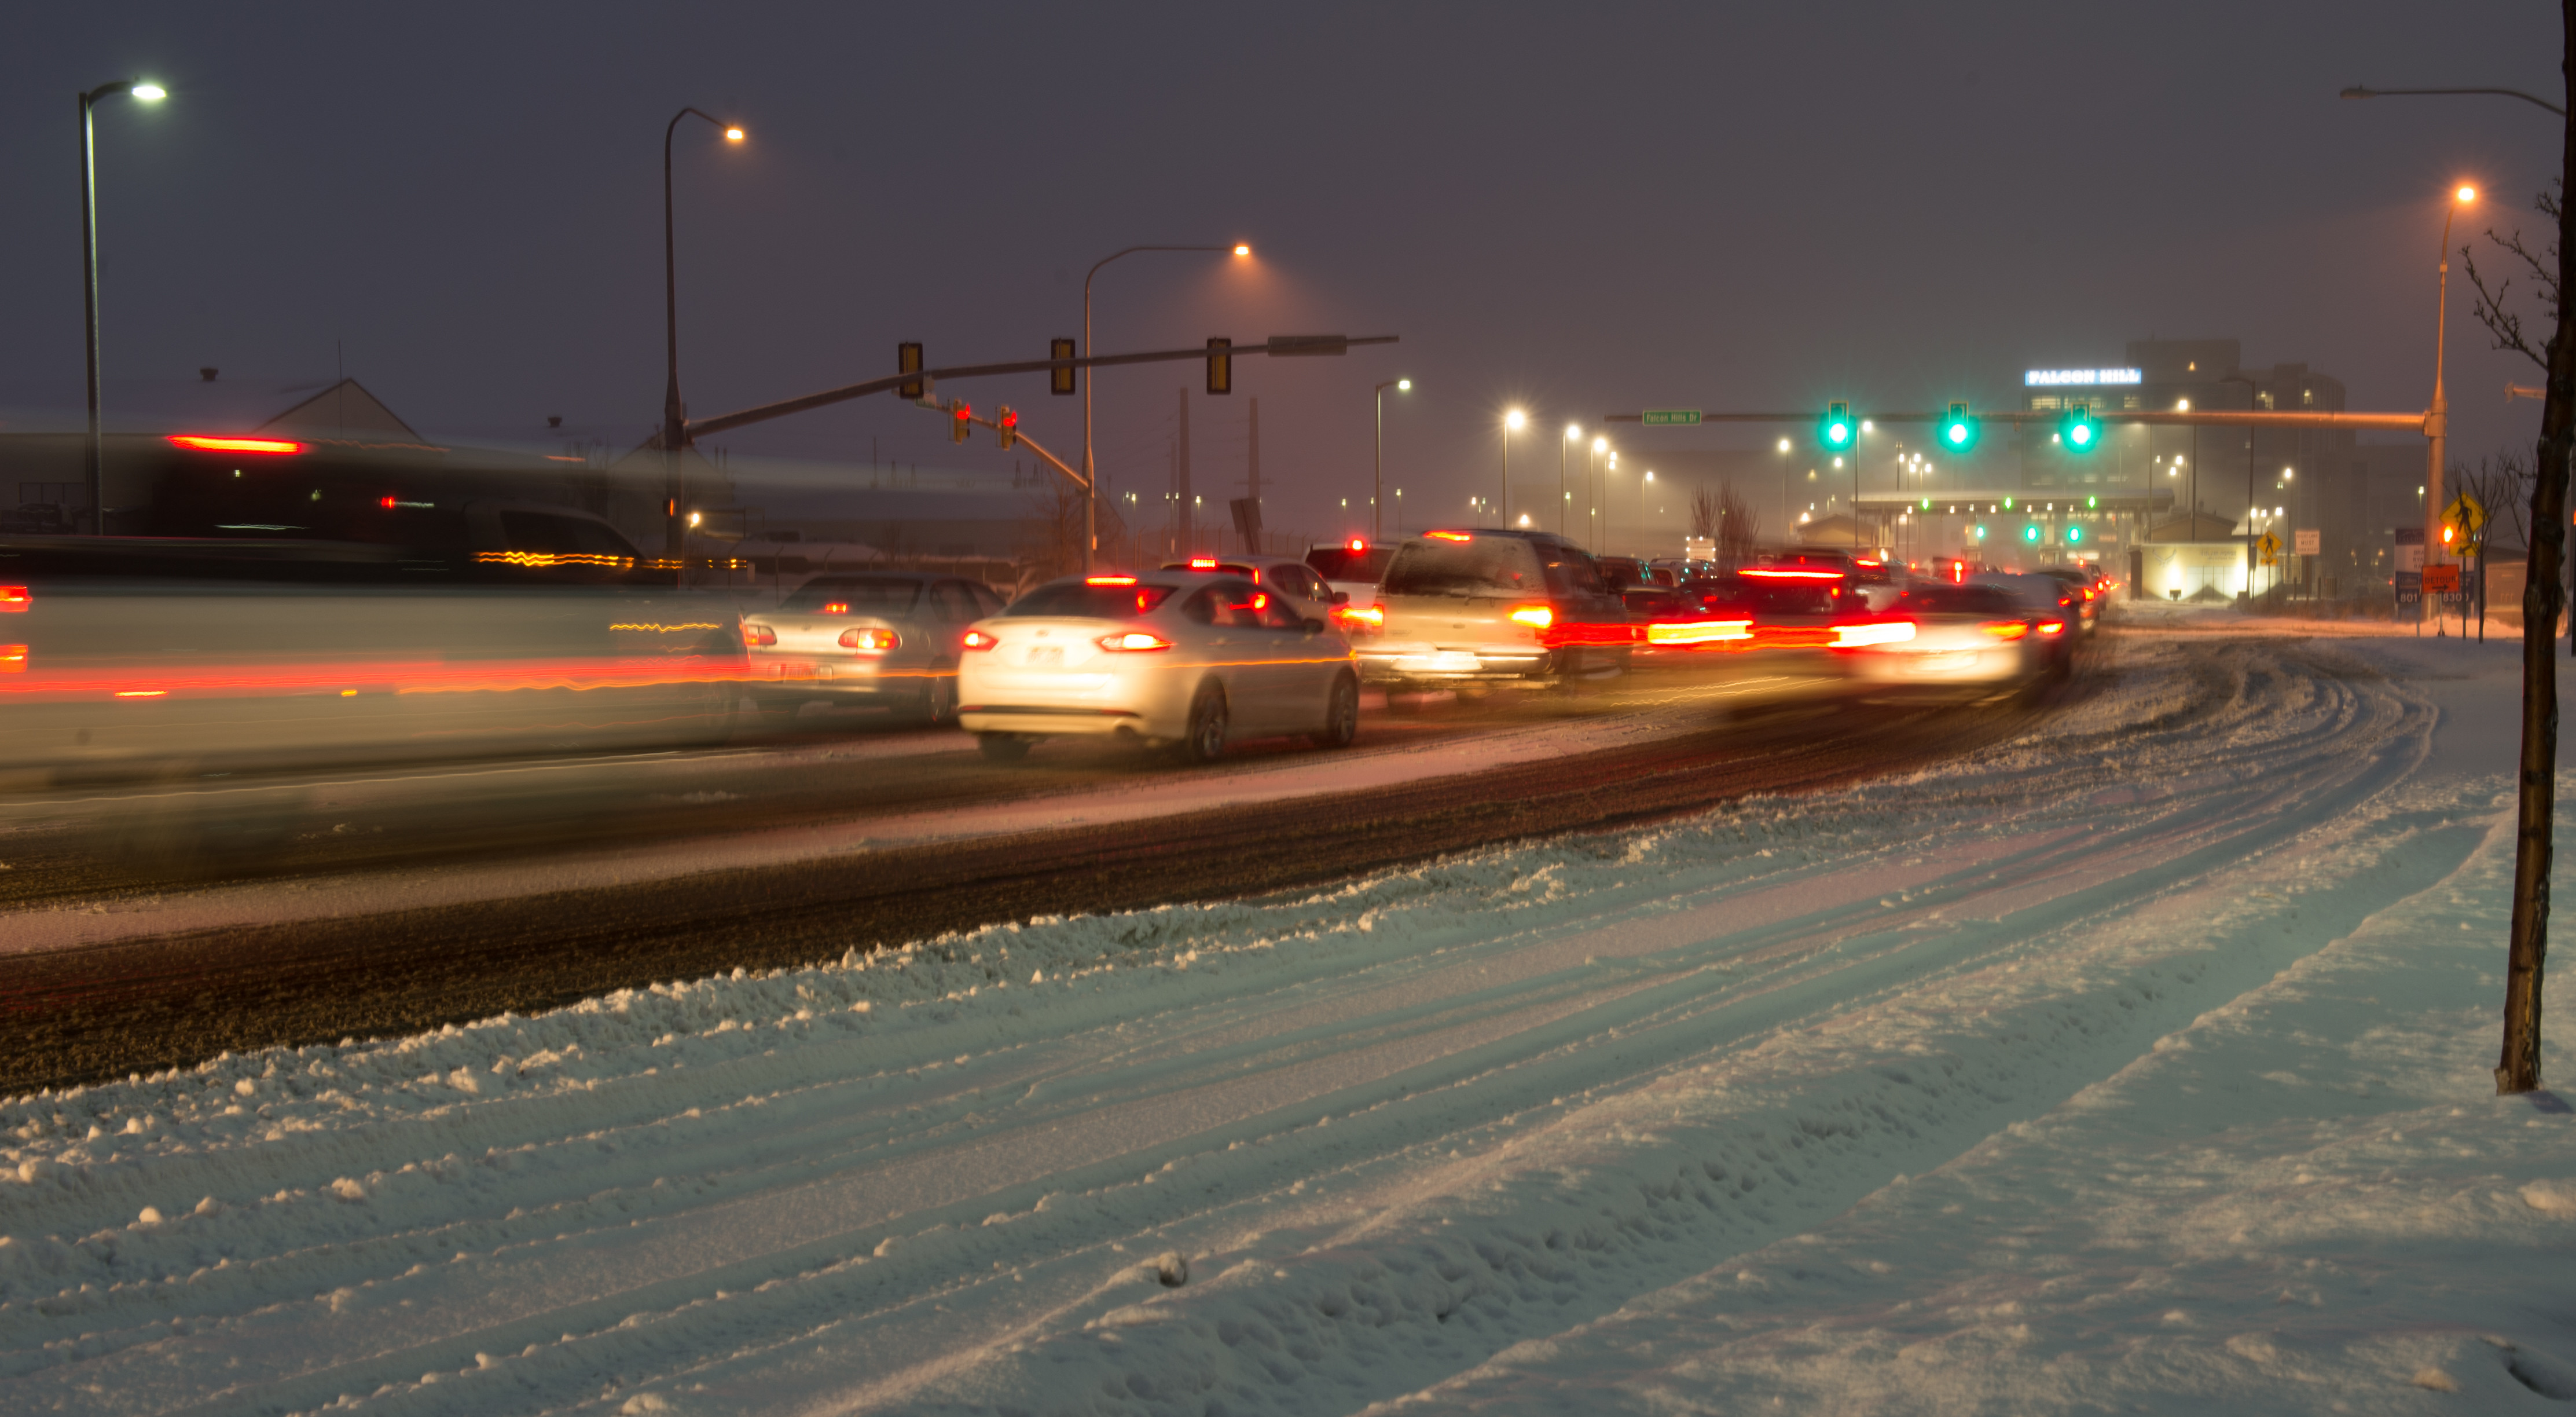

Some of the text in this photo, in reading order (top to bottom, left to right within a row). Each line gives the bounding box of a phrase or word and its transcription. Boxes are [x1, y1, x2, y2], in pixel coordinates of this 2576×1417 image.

[2028, 369, 2139, 384] FALCON HILL
[1646, 413, 1697, 422] Falcon Hills Dr
[2425, 576, 2456, 584] DETOUR
[2400, 594, 2417, 602] 801
